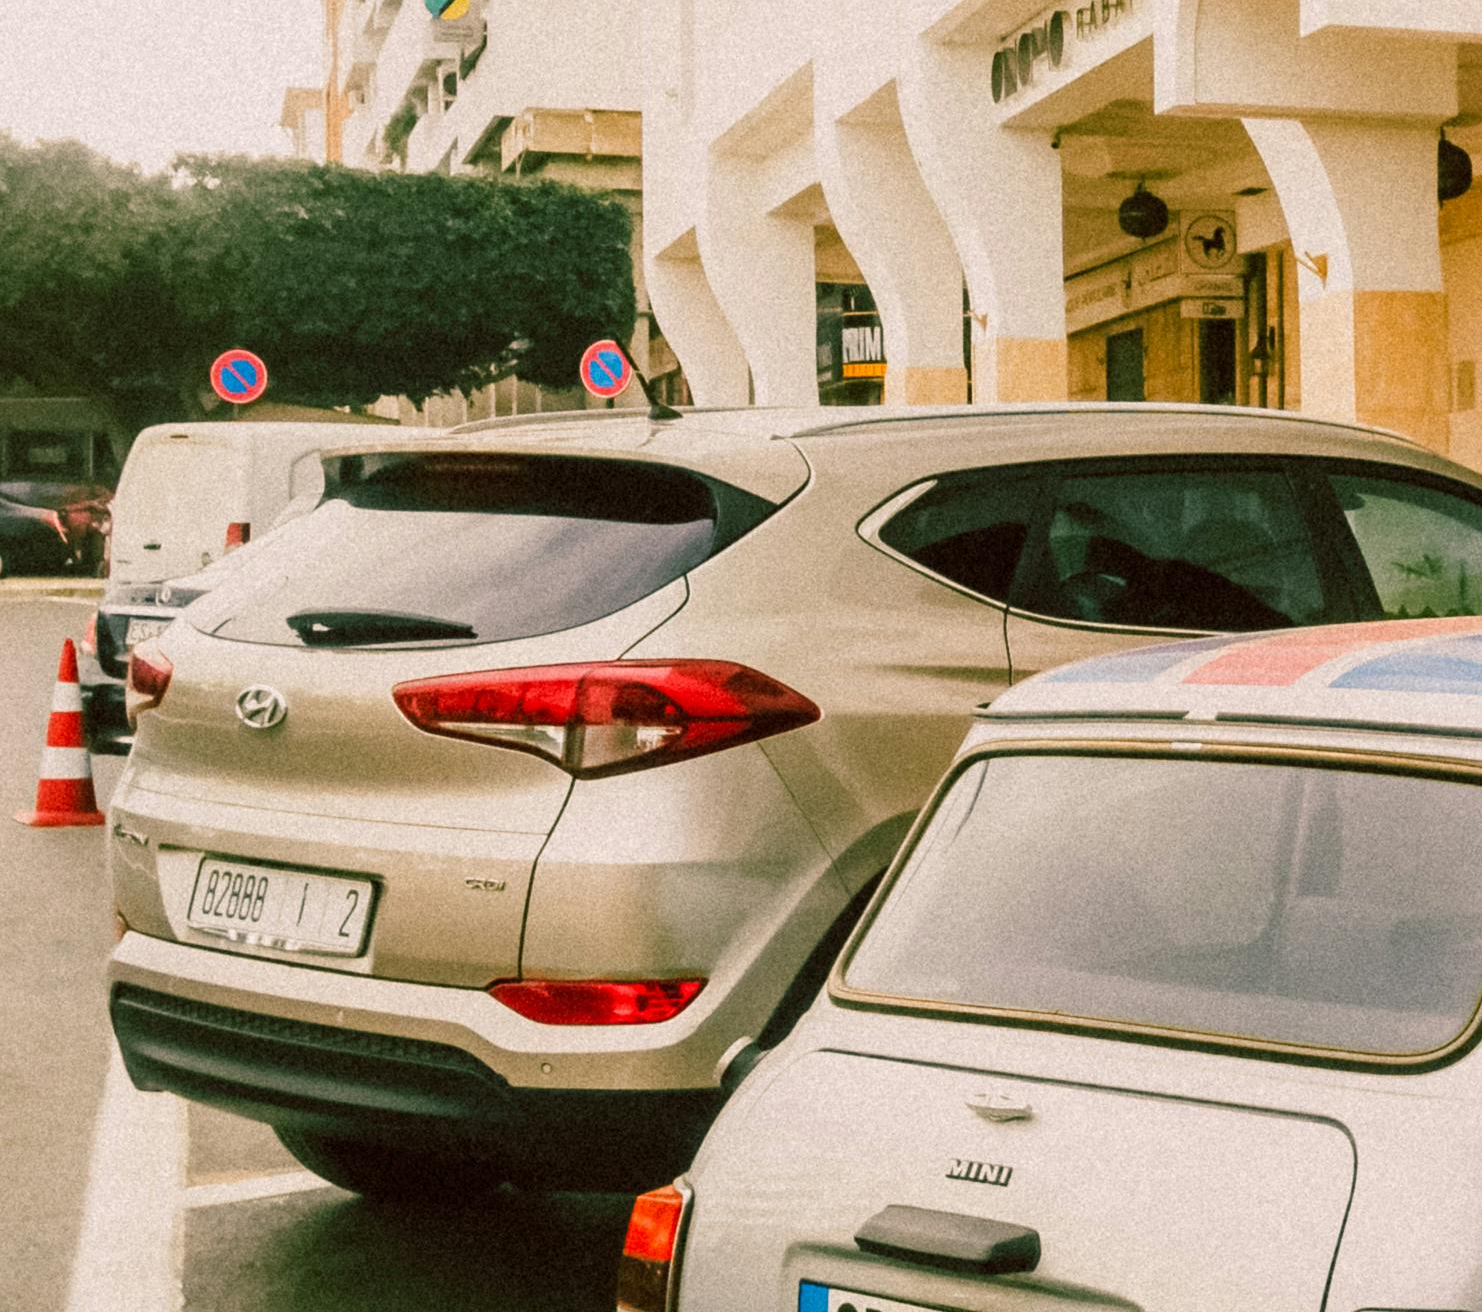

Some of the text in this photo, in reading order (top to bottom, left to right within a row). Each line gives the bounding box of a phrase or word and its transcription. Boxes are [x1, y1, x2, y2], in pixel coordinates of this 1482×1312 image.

[202, 869, 269, 923] 82888
[338, 889, 359, 938] 2
[944, 1158, 1014, 1188] MINI
